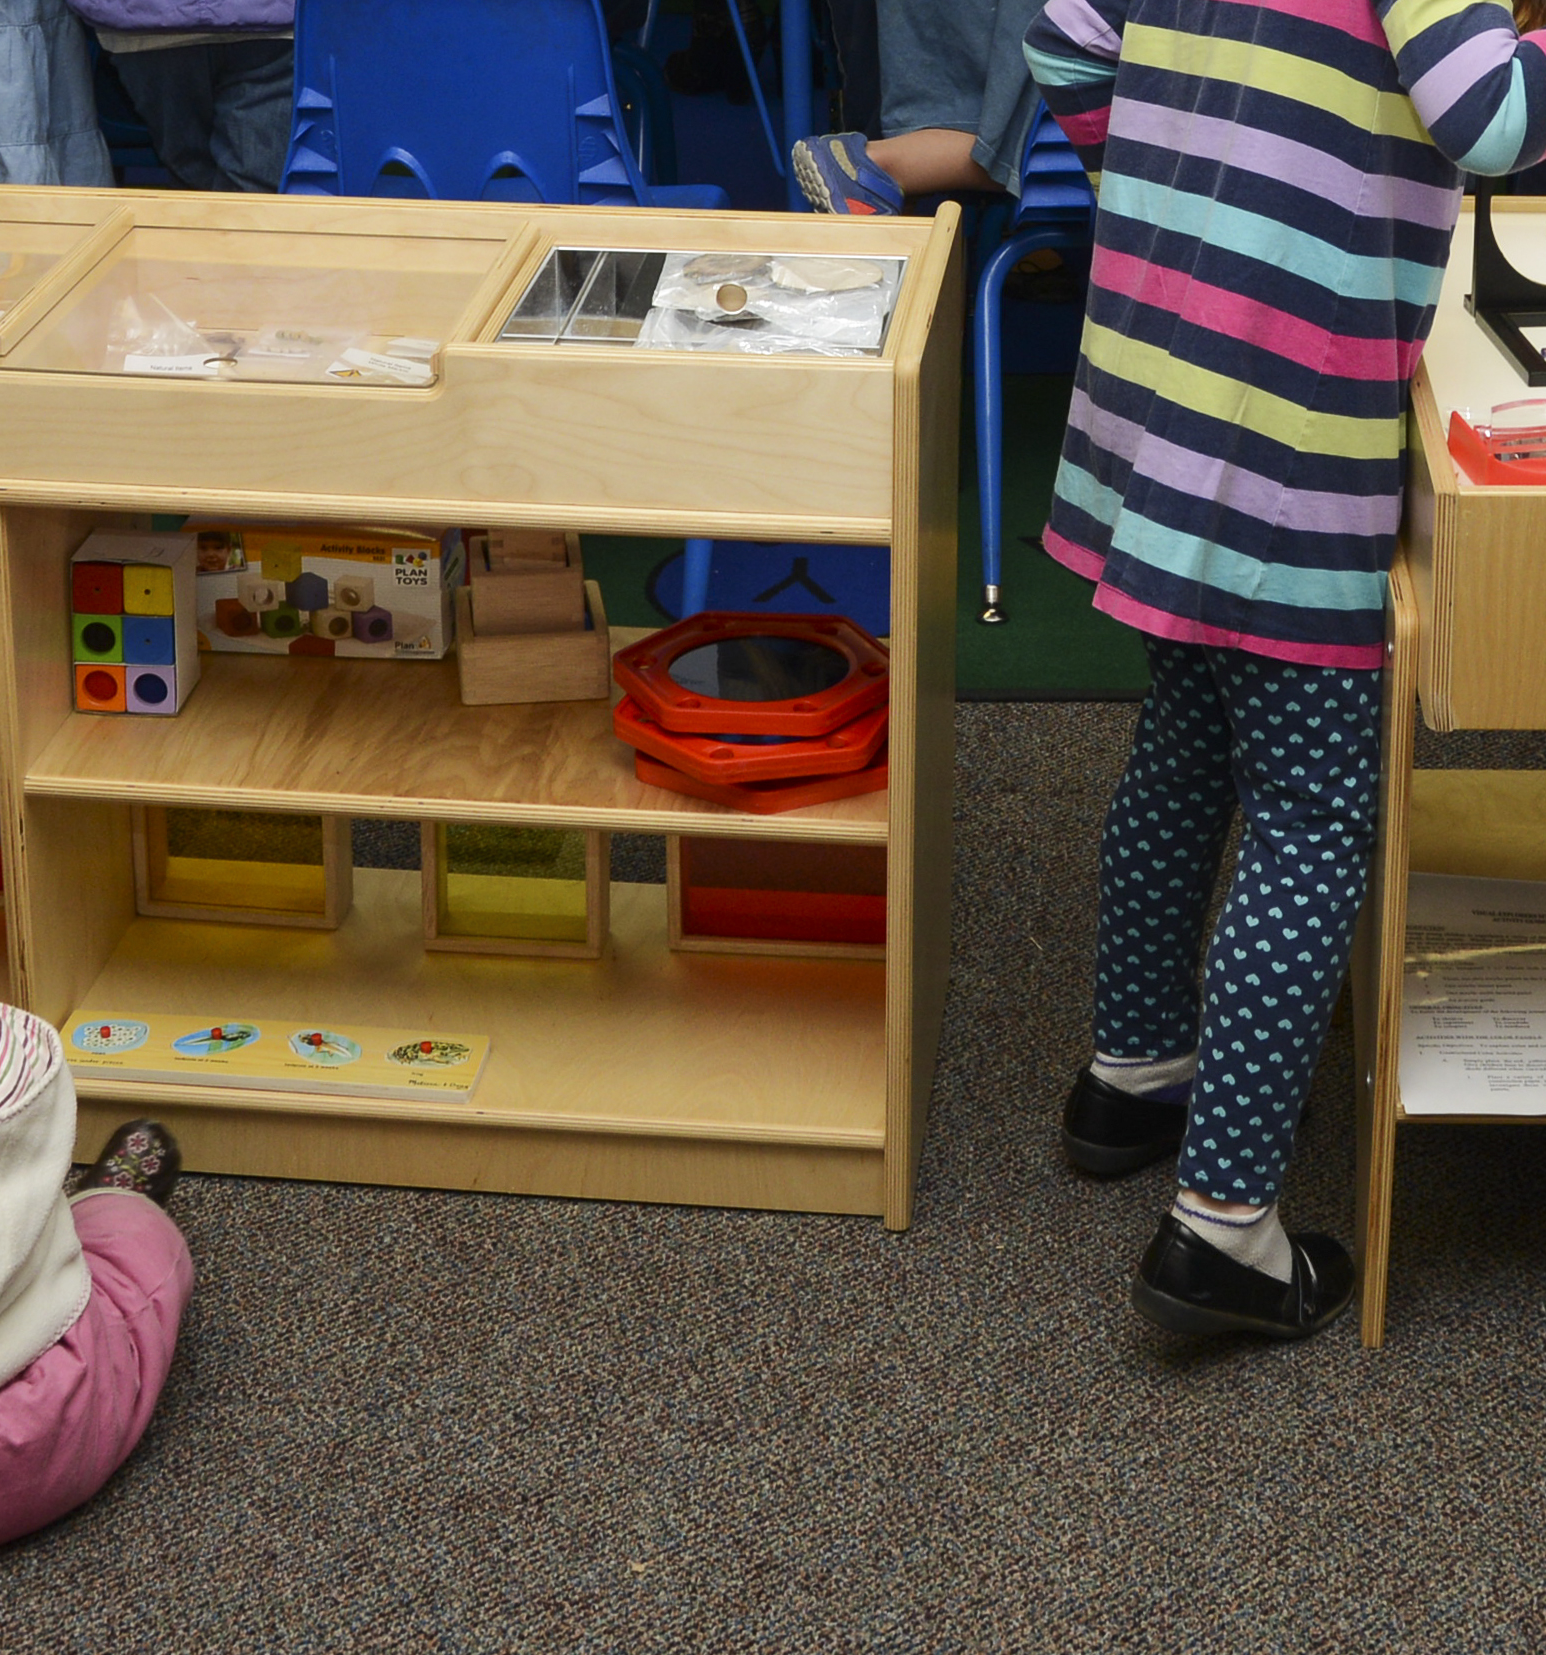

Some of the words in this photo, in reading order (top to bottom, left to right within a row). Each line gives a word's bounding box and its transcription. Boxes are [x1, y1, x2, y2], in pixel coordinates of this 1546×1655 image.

[150, 364, 175, 372] Natural
[320, 543, 354, 555] Activity
[356, 545, 386, 555] Blocks
[395, 568, 428, 577] PLAN
[395, 577, 428, 586] TOYS
[395, 641, 415, 650] Plan
